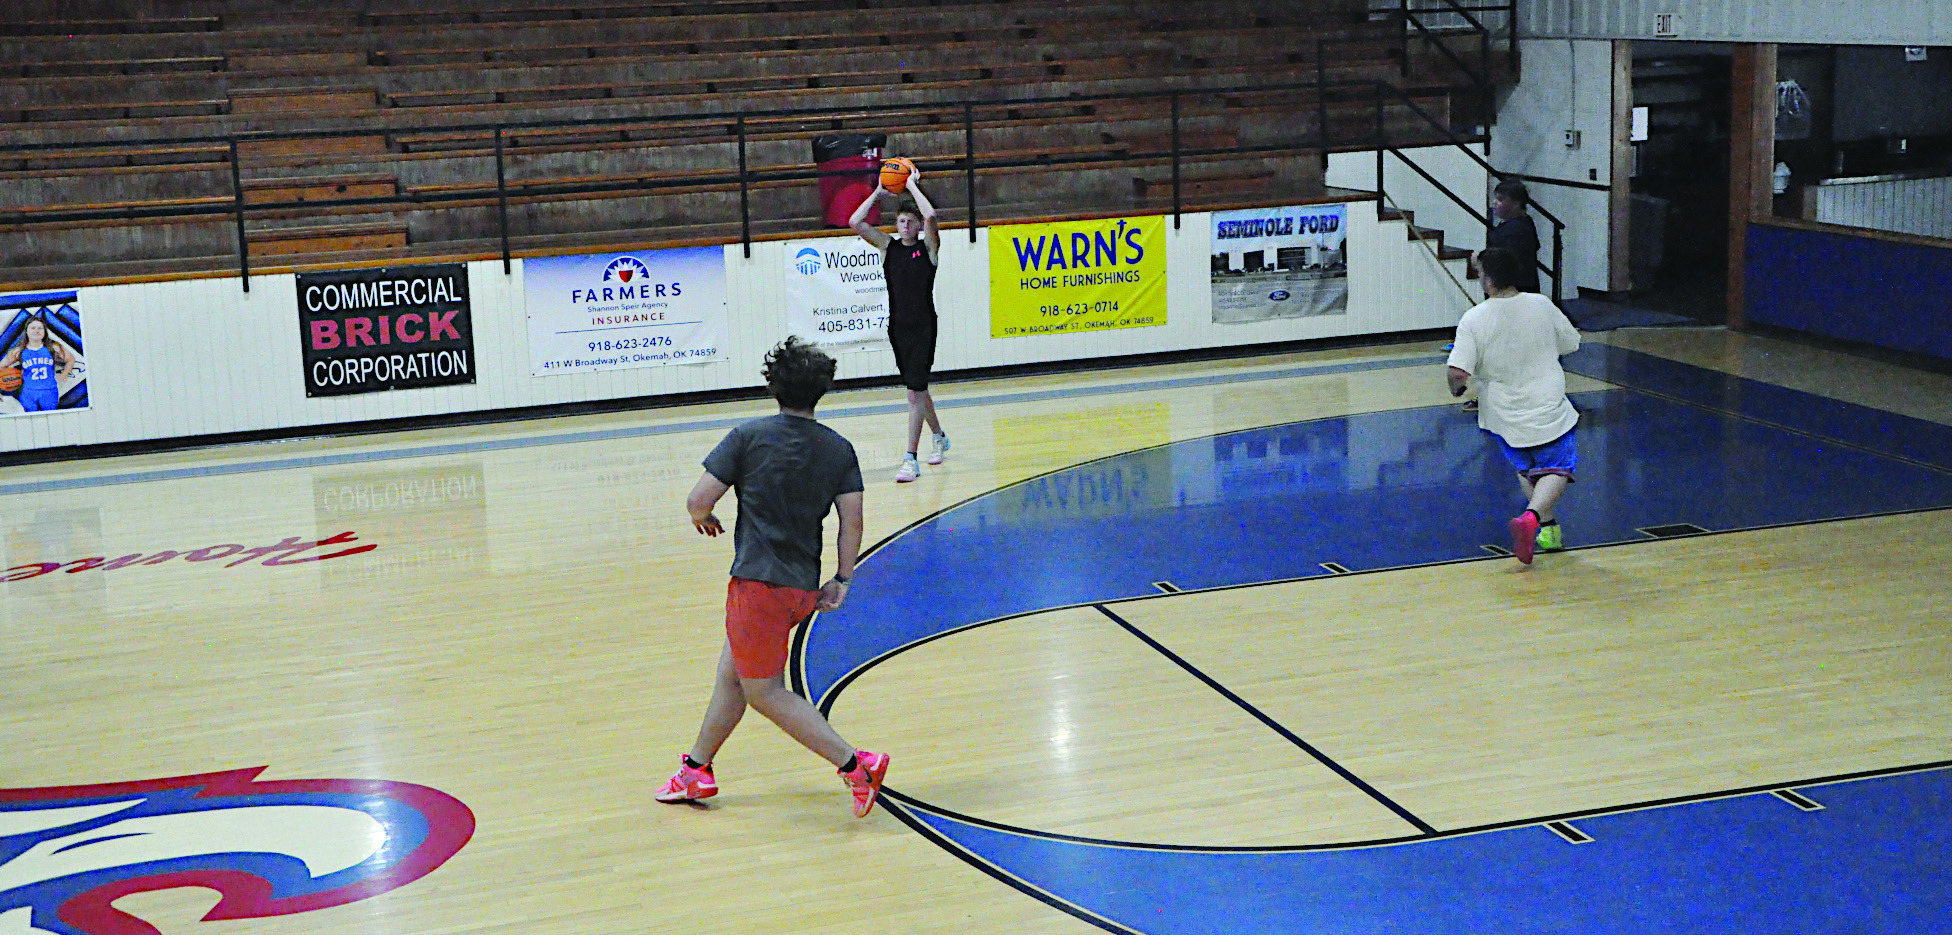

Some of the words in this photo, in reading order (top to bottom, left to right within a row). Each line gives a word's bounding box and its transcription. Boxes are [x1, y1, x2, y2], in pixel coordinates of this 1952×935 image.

[1657, 14, 1671, 33] EXIT
[1217, 216, 1293, 240] SEMINOLE
[1299, 214, 1339, 235] FORD
[1012, 219, 1144, 272] WARN'S
[825, 249, 880, 269] Woodm
[840, 270, 887, 283] Wewok
[1020, 276, 1058, 290] HOME
[1063, 270, 1141, 288] FURNISHINGS
[305, 277, 462, 313] COMMERCIAL
[572, 282, 682, 304] FARMERS
[587, 305, 620, 313] Shannon
[621, 303, 640, 311] Speir
[641, 302, 669, 310] Agency
[812, 306, 848, 317] Kristina
[850, 303, 886, 314] Calvert,
[1040, 301, 1119, 317] 918-623-0714
[592, 312, 665, 326] INSURANCE
[818, 316, 890, 333] 405-831-73
[1004, 327, 1017, 335] 507
[1029, 324, 1068, 333] BROADWAY
[1120, 318, 1131, 326] OK
[1134, 316, 1154, 325] 74859
[310, 310, 462, 351] BRICK
[588, 336, 672, 352] 918-623-2476
[544, 360, 560, 369] 411
[563, 359, 573, 368] W
[575, 356, 618, 368] Broadway
[633, 352, 672, 362] Okemah,
[673, 350, 687, 359] OK
[689, 347, 717, 358] 74859
[31, 366, 48, 380] 23
[313, 350, 468, 387] CORPORATION
[0, 533, 378, 583] Home
